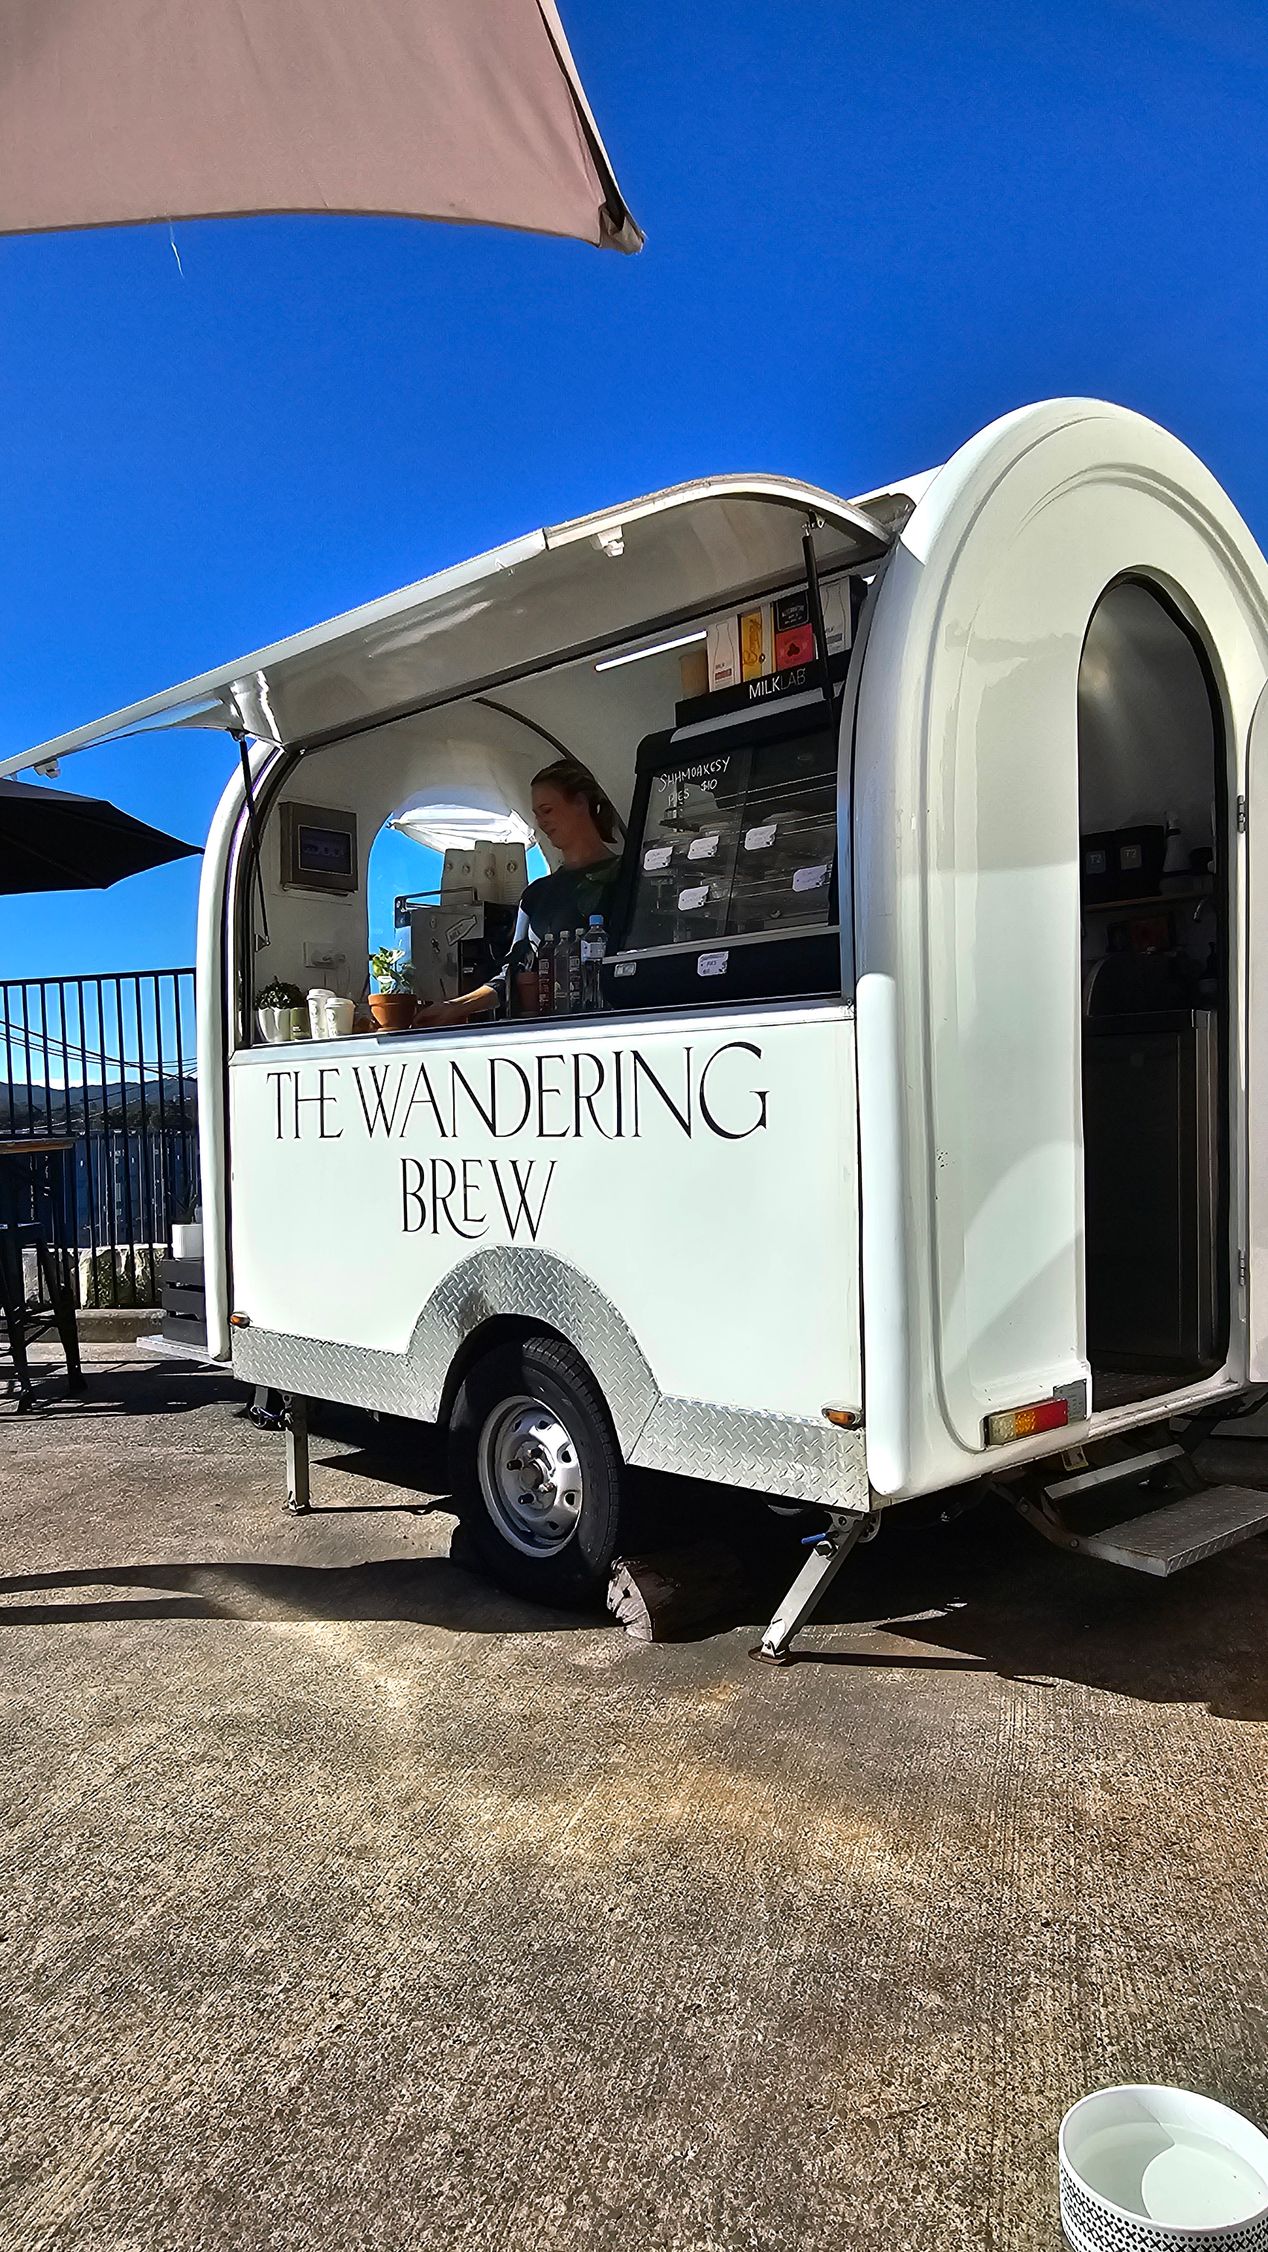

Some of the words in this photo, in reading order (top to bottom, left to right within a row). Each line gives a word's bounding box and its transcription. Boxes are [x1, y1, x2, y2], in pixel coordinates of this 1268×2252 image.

[749, 668, 806, 699] MILKLAB
[266, 1068, 344, 1139] THE
[351, 1041, 770, 1140] WANDERING
[400, 1157, 557, 1242] BREW
